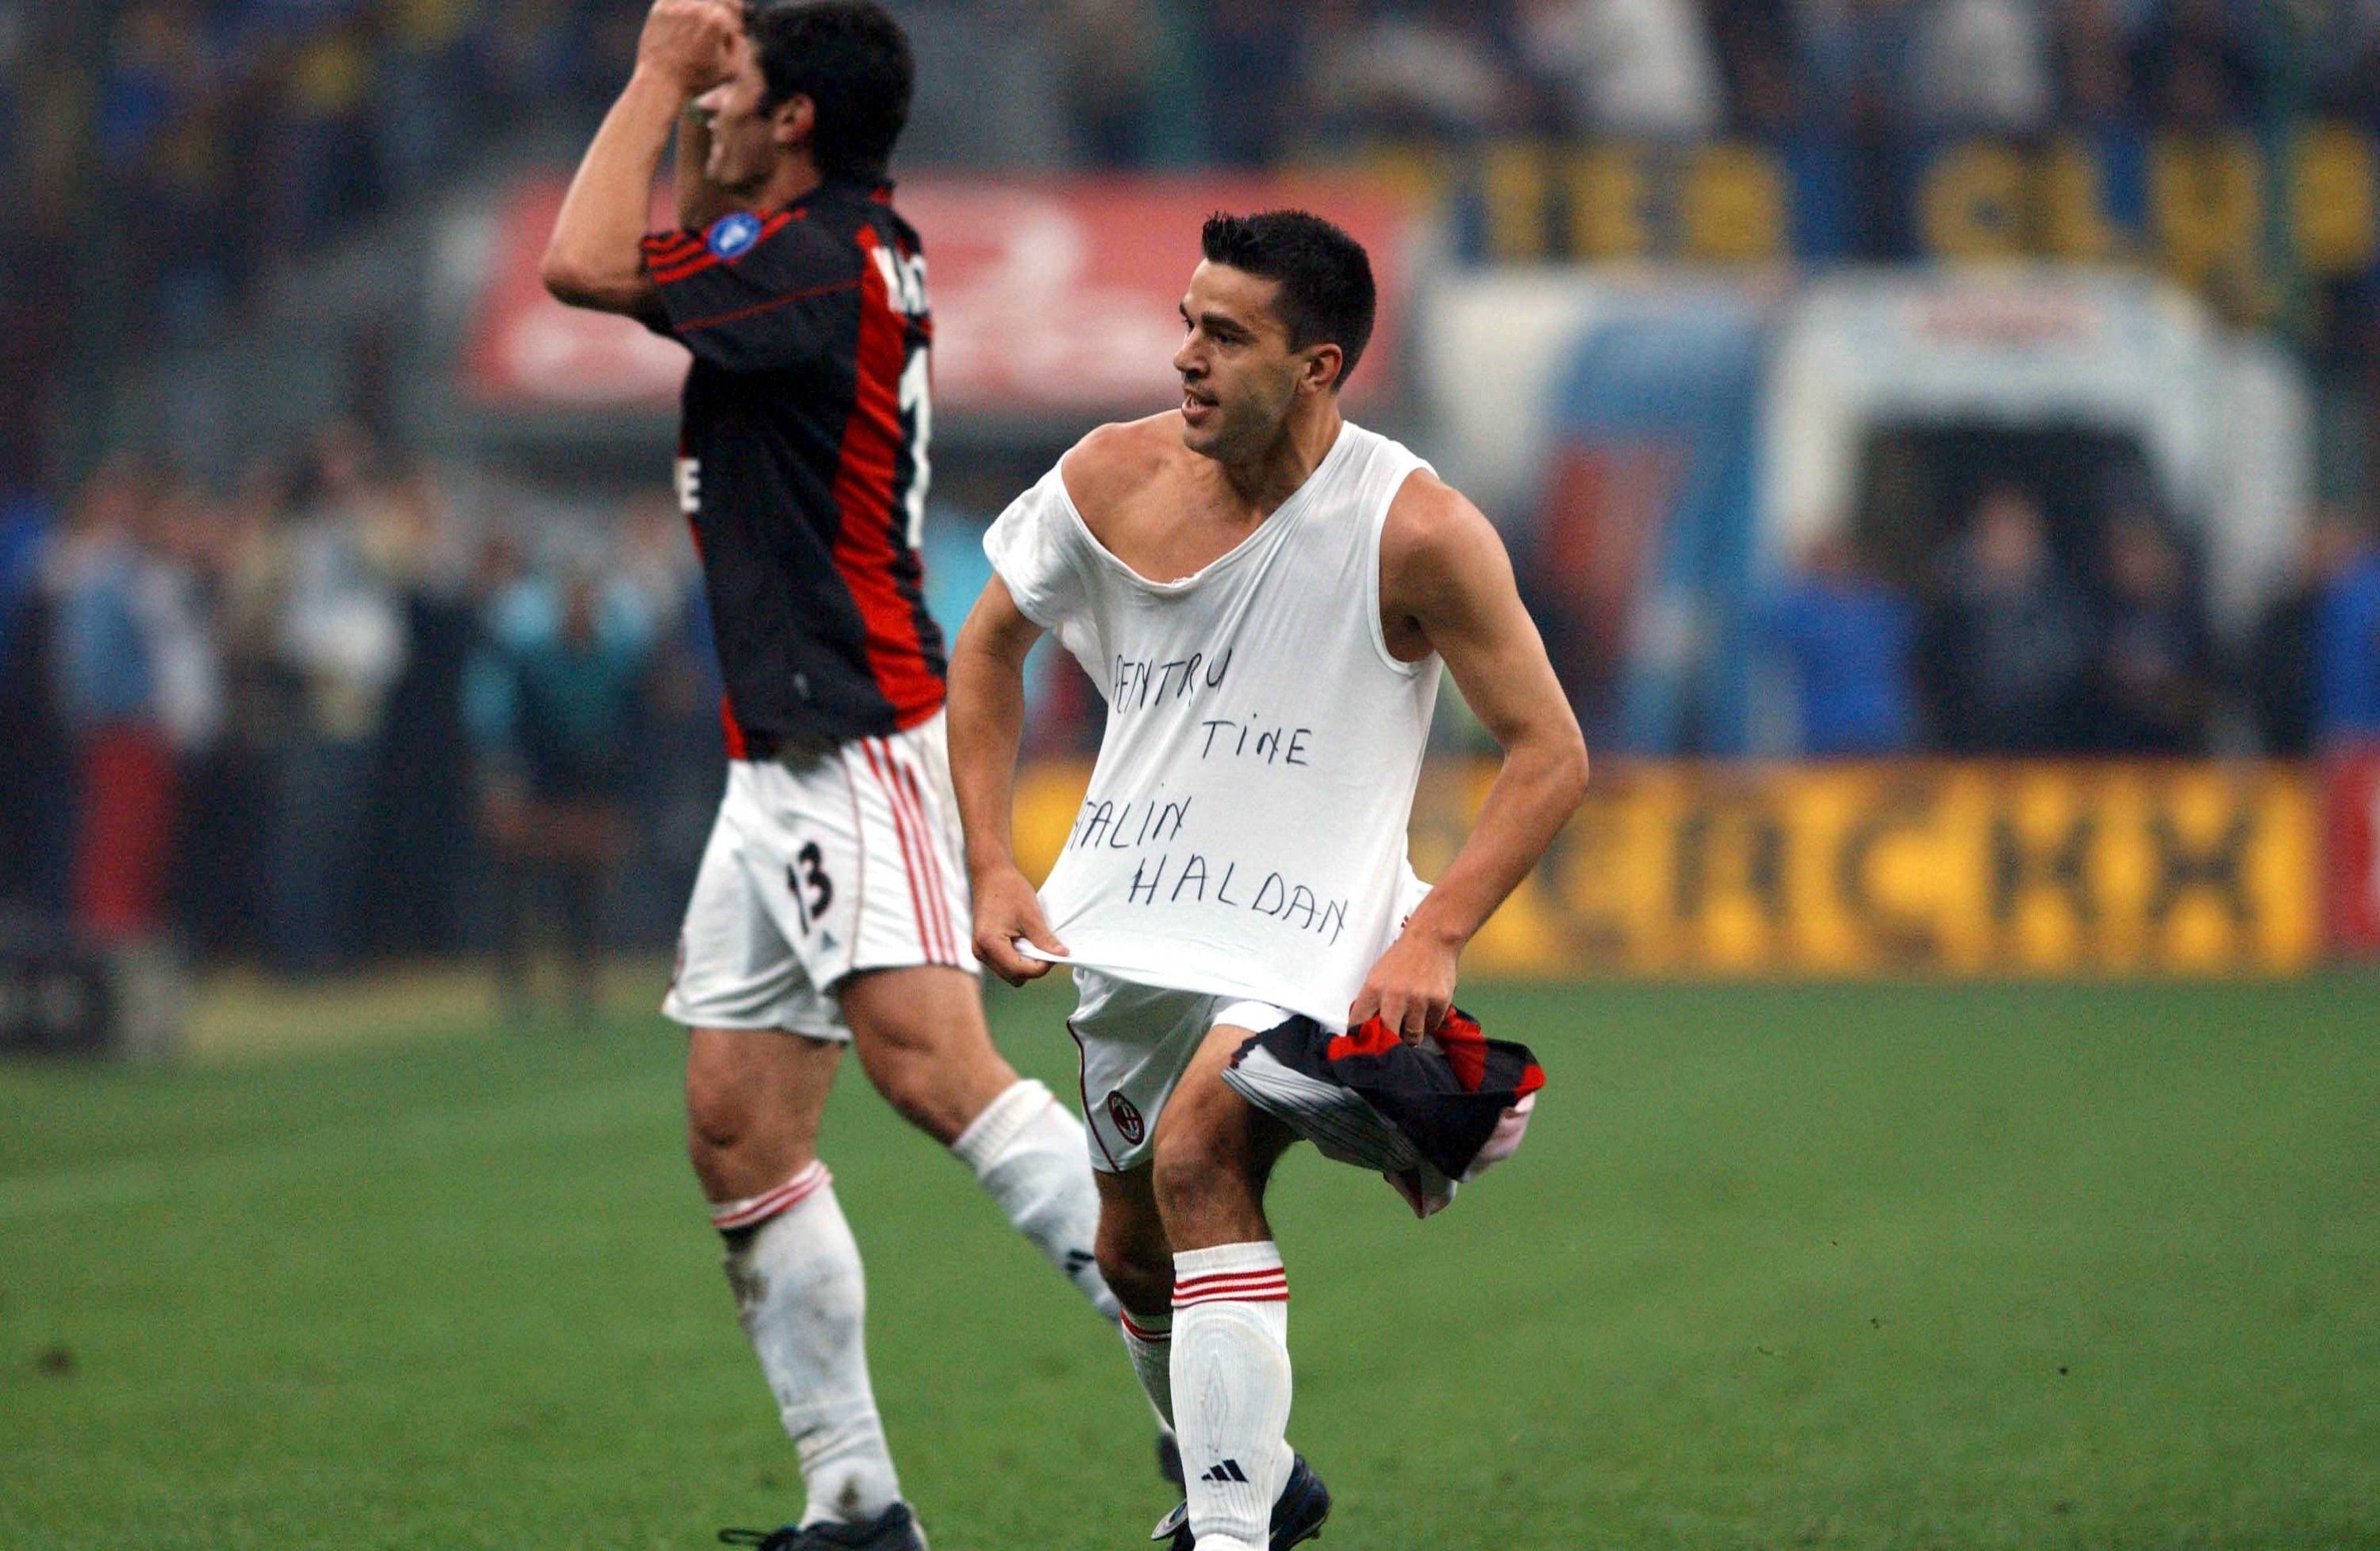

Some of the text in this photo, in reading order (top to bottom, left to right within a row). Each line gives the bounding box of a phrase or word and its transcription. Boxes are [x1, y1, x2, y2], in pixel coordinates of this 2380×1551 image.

[1112, 647, 1232, 714] PENTRU
[1071, 782, 1192, 852] TALIN
[786, 841, 833, 935] 13
[1128, 854, 1349, 946] HALDAN
